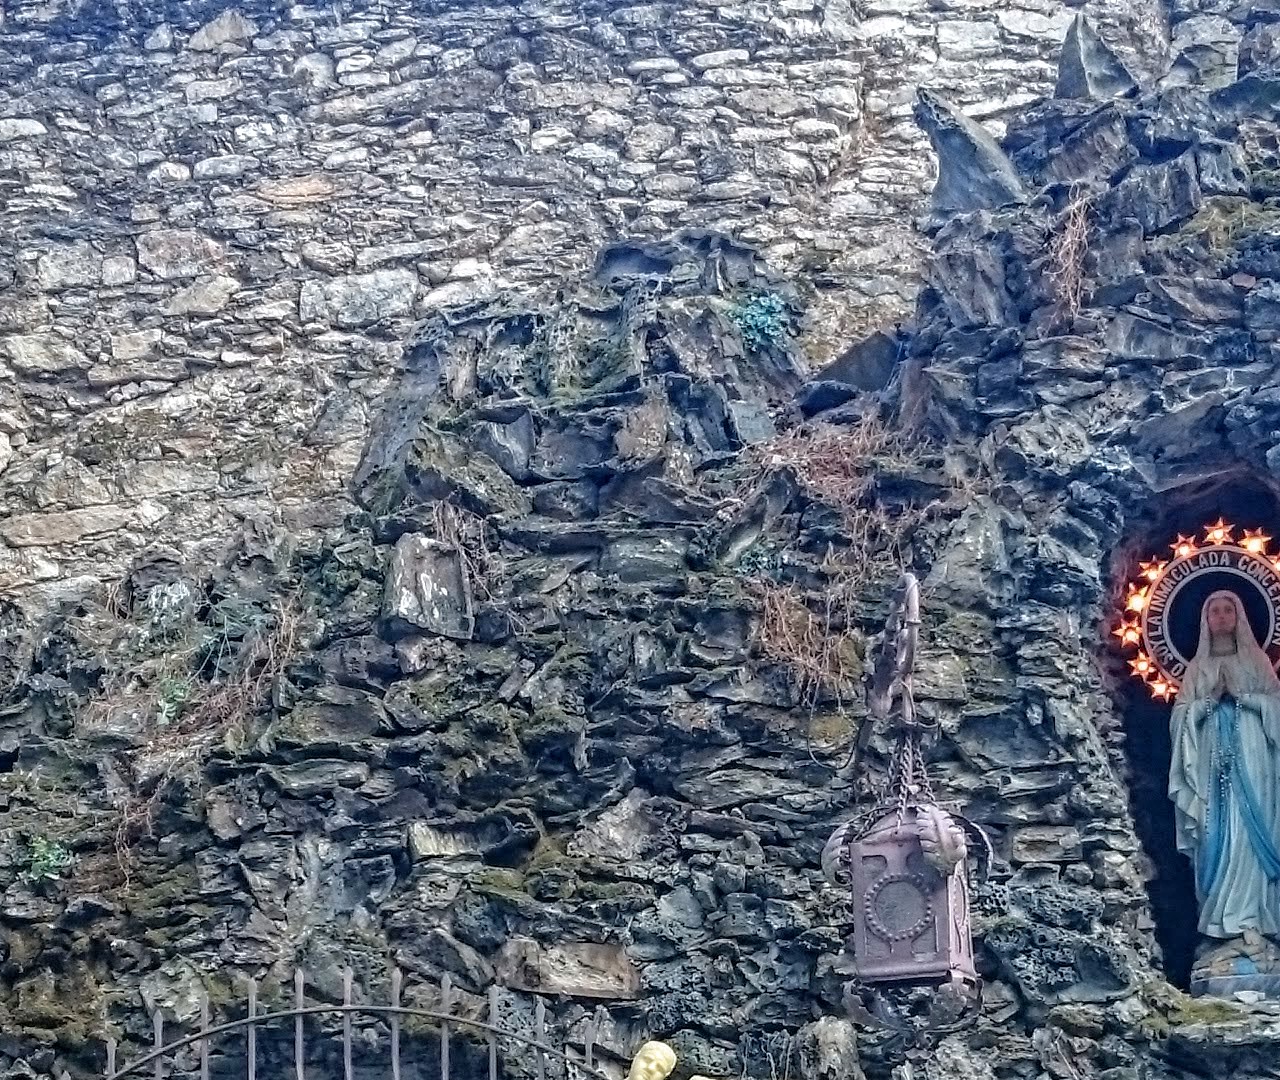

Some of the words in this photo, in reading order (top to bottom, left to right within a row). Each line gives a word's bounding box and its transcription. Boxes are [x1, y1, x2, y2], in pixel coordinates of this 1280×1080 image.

[1149, 551, 1231, 614] INMACULADA
[1147, 614, 1163, 636] LA
[1149, 640, 1174, 666] SOY
